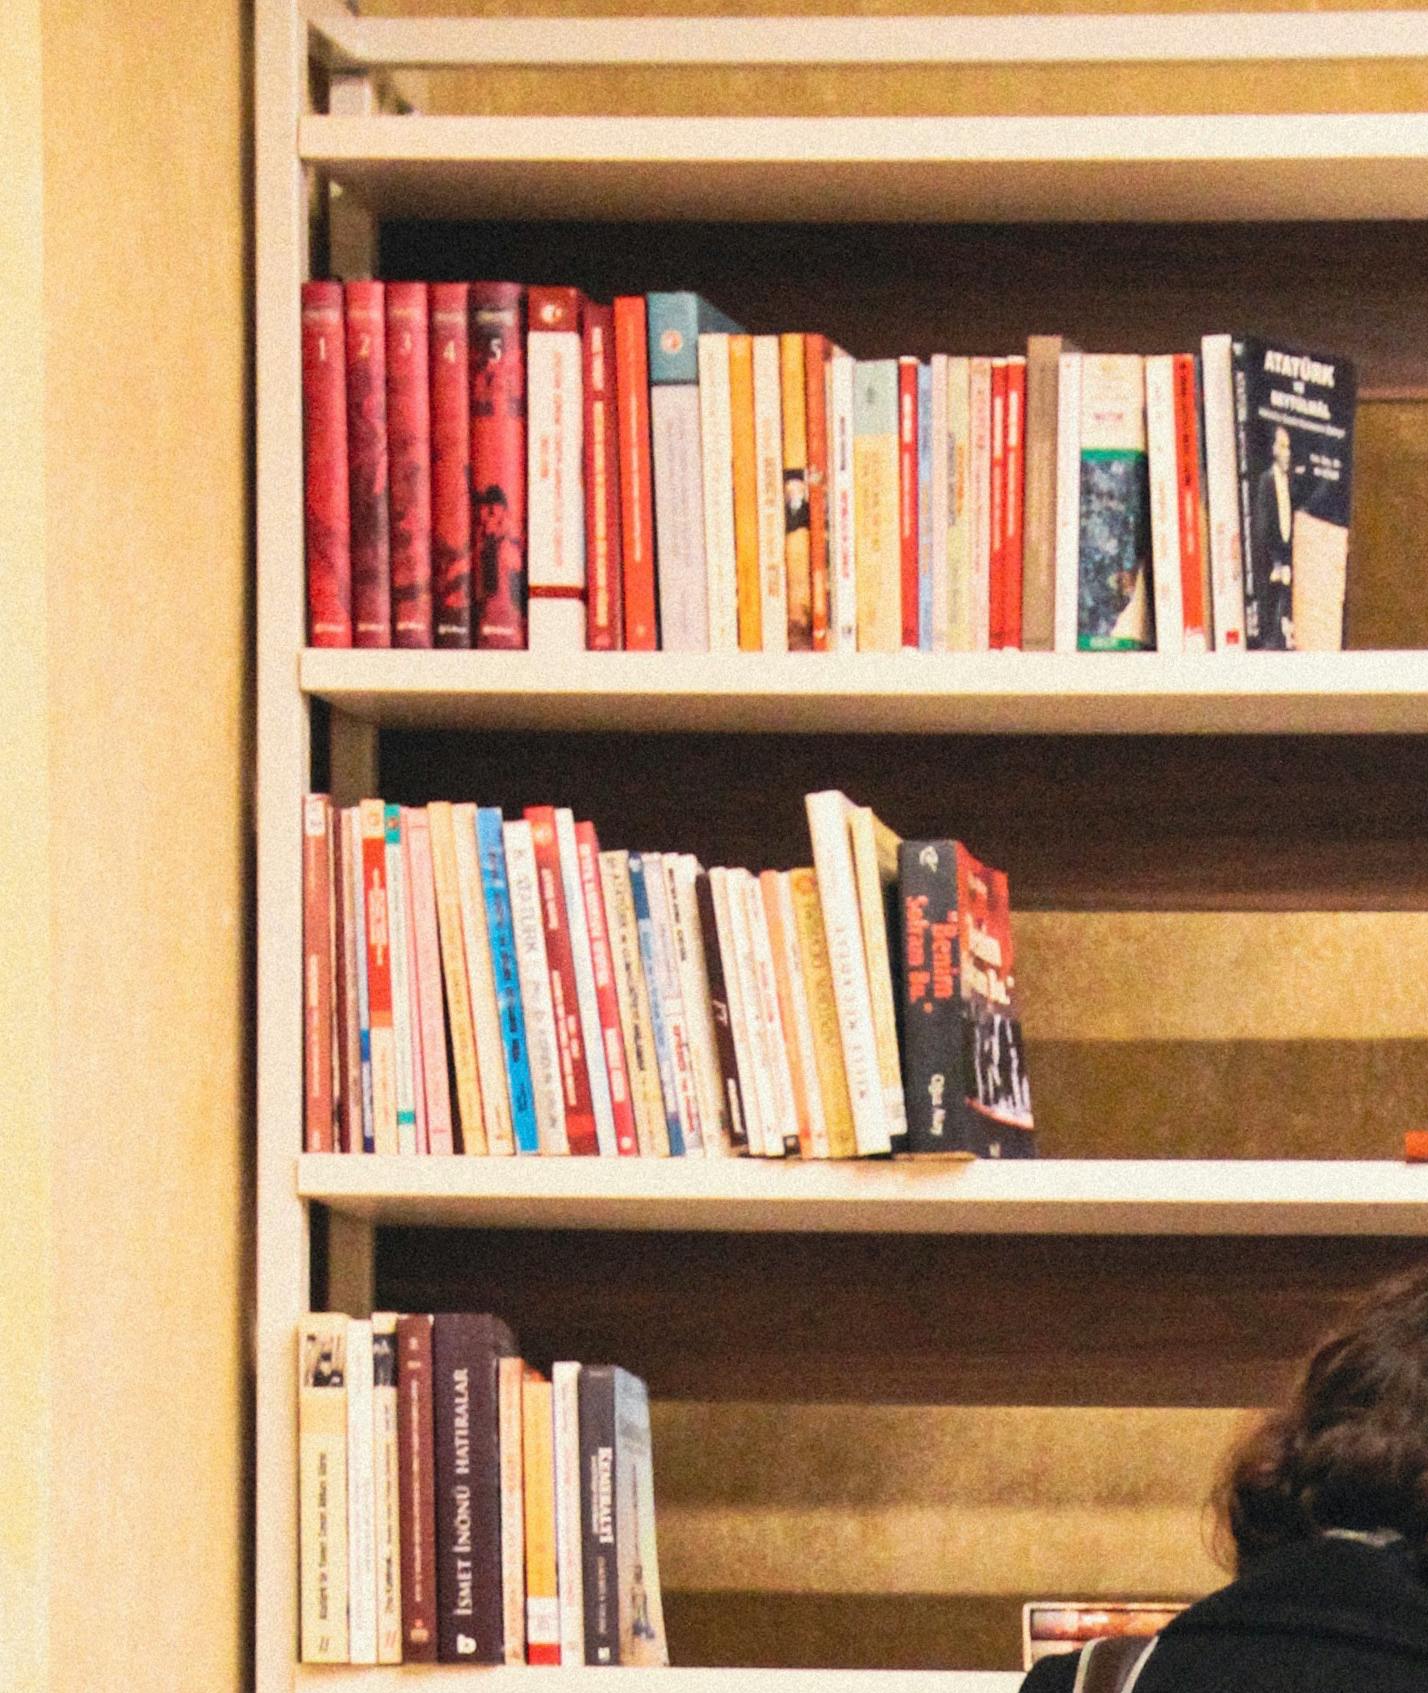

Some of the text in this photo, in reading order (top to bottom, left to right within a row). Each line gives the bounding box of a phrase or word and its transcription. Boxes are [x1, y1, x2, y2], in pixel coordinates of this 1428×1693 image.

[319, 337, 326, 362] 1
[443, 340, 456, 363] 4
[490, 338, 502, 362] 5
[1264, 350, 1335, 388] ATATÜRK
[452, 1368, 473, 1616] İSMET İNÖNÜ HATIRALAR
